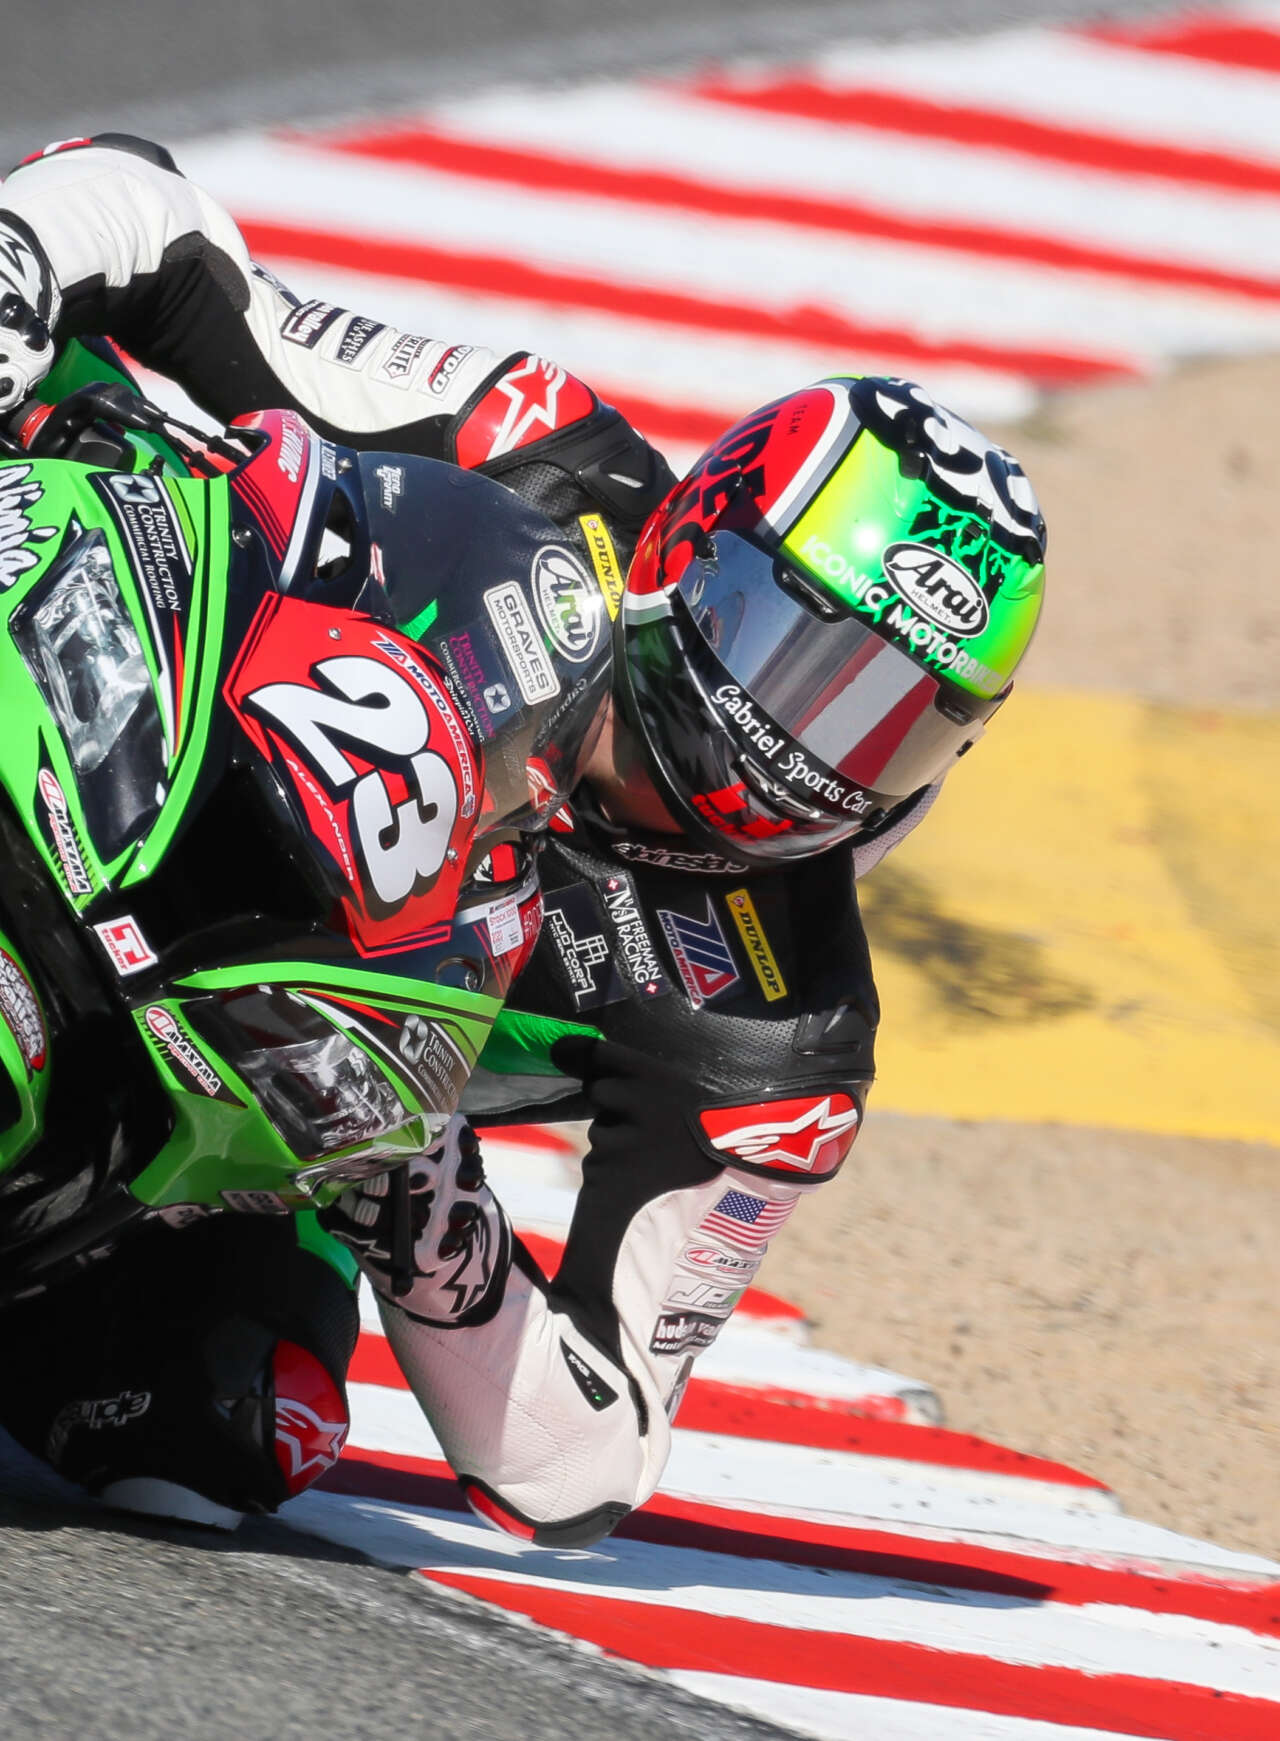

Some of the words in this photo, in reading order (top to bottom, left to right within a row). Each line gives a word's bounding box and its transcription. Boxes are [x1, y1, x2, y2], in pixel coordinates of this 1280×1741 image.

[138, 504, 181, 611] CONSTRUCTION
[152, 505, 178, 561] TRINITY
[800, 535, 889, 610] ICONIC
[541, 556, 594, 646] Arai
[886, 559, 983, 624] Arai
[458, 633, 487, 684] TRINITY
[493, 599, 536, 694] MOTORSPORTS
[504, 594, 550, 689] GRAVES
[449, 635, 496, 738] CONSTRUCTION
[248, 656, 456, 904] 23
[710, 685, 781, 760] Gabriel
[778, 751, 845, 804] Sports
[286, 758, 354, 881] ALEXANDER
[551, 915, 571, 945] JJD
[566, 949, 588, 988] CORP
[617, 924, 650, 984] RACING
[631, 919, 662, 980] FREEMAN
[740, 914, 780, 993] DUNLOP
[165, 1030, 221, 1092] MAXIMA
